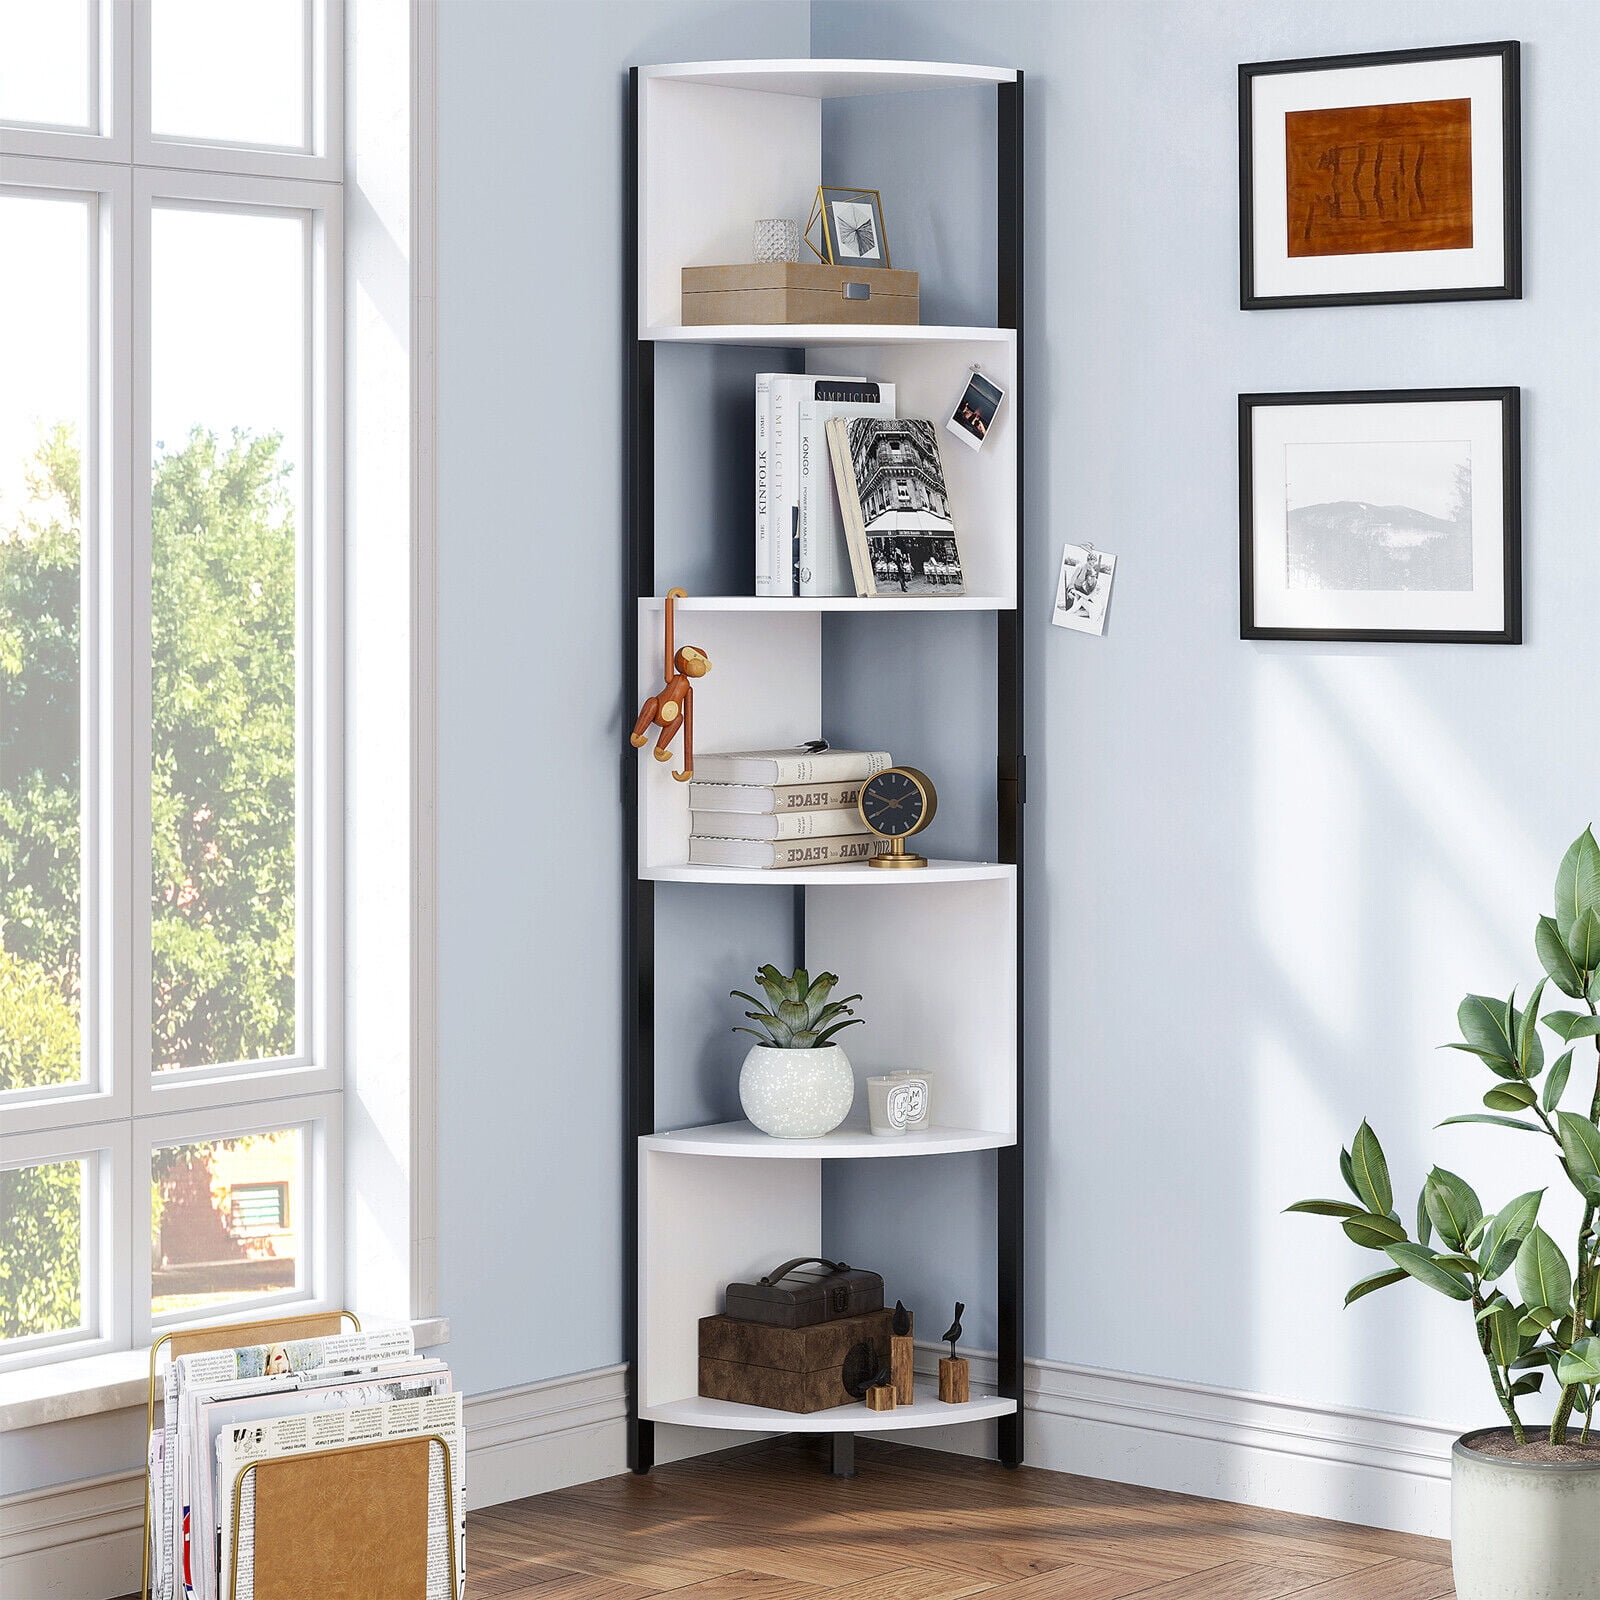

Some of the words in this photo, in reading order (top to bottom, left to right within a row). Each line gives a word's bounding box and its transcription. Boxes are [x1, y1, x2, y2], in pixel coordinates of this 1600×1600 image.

[816, 391, 878, 403] SIMPLICITY
[775, 394, 783, 502] SIMPLICITY
[759, 450, 767, 515] KINFOLK
